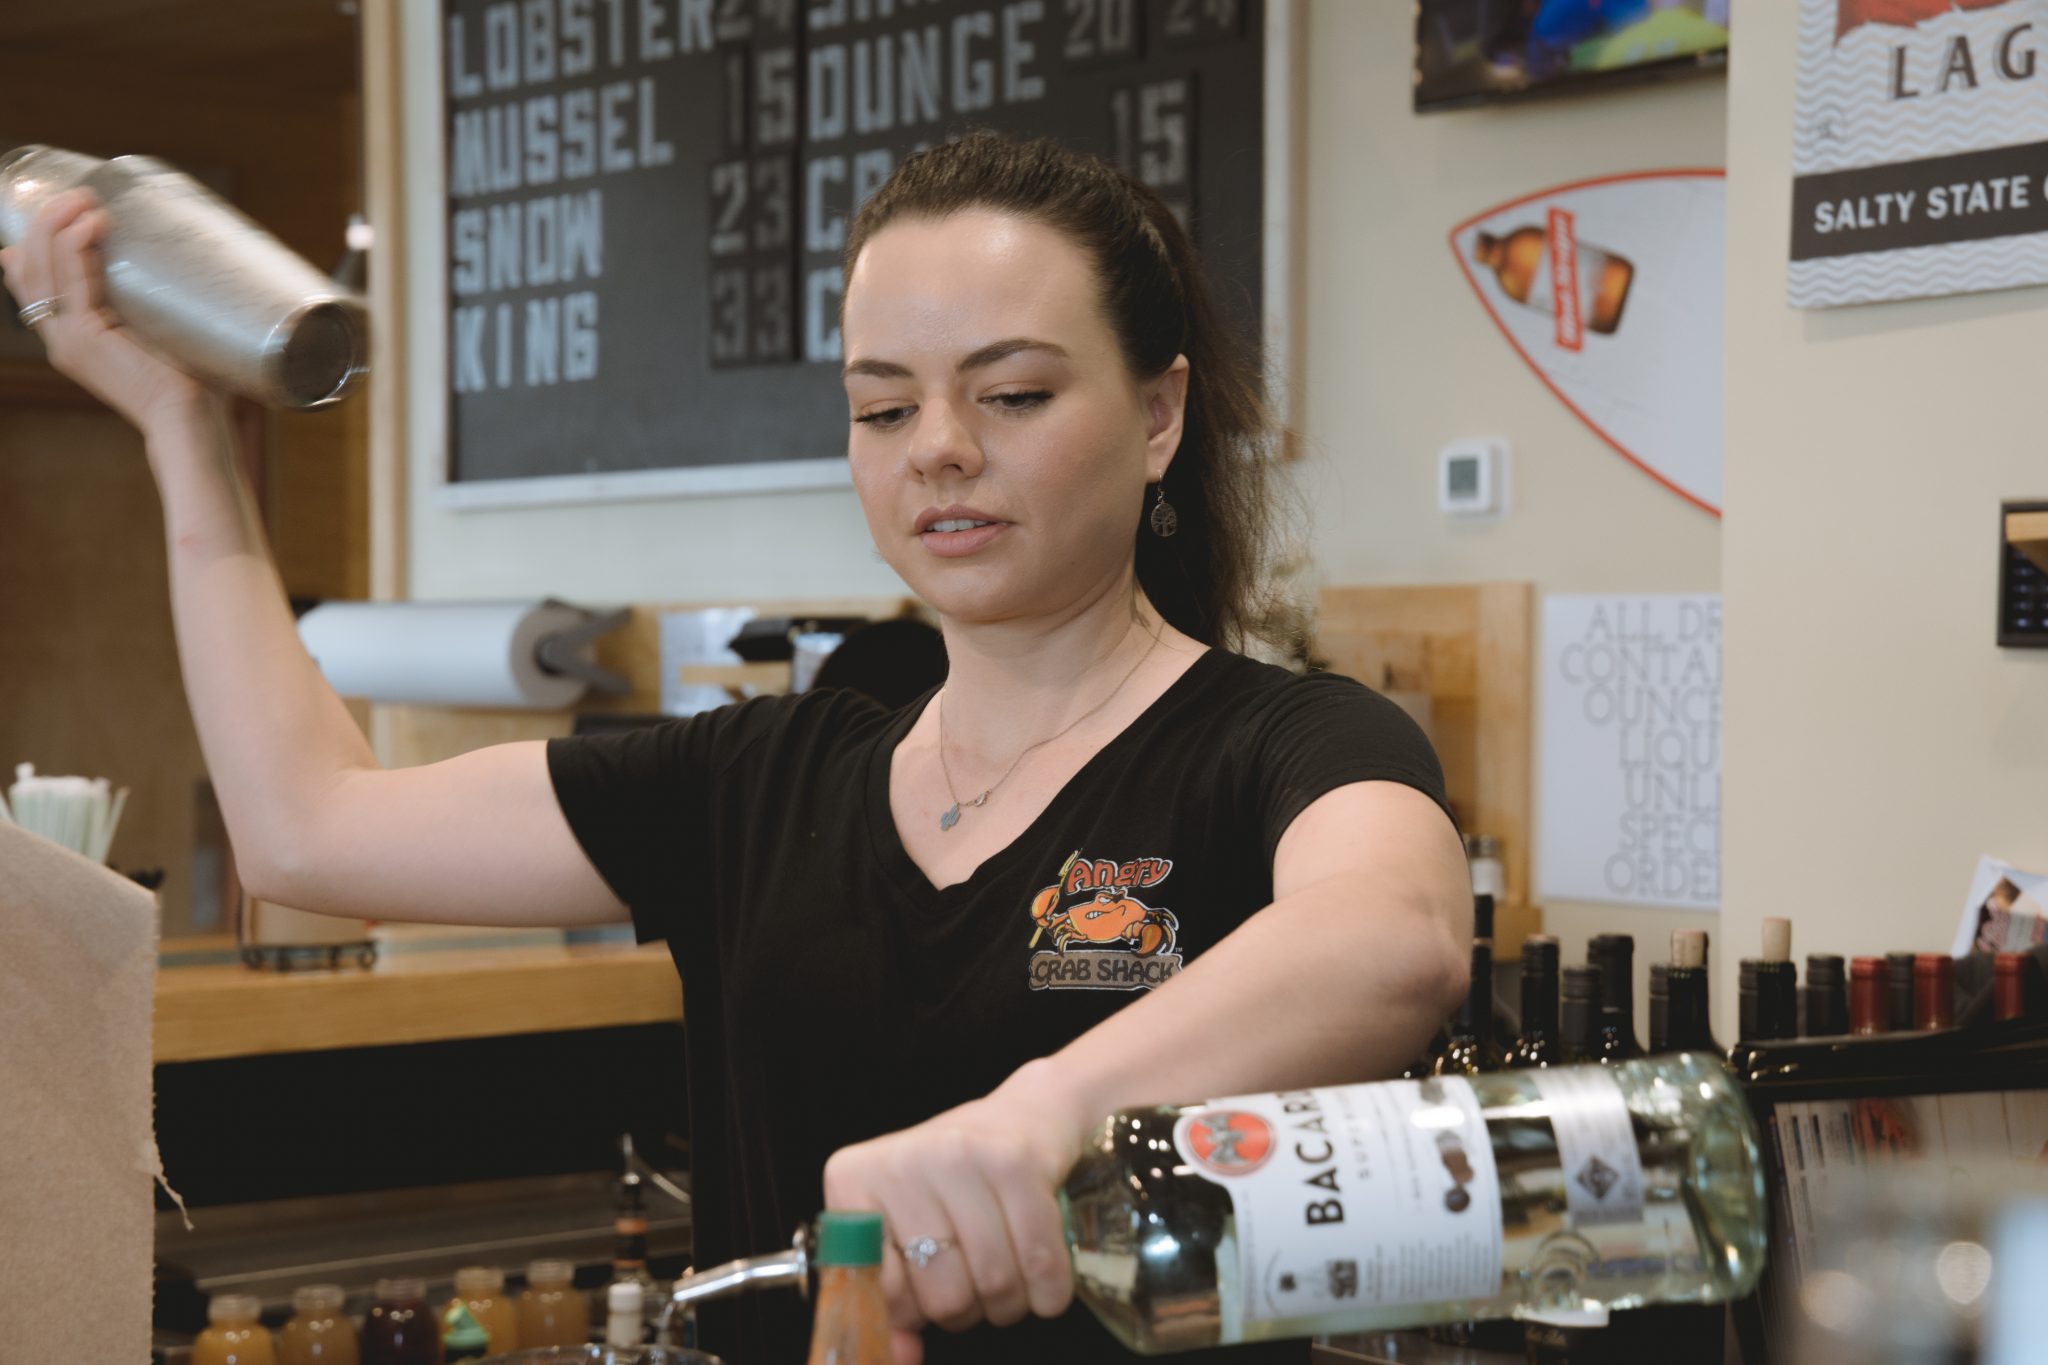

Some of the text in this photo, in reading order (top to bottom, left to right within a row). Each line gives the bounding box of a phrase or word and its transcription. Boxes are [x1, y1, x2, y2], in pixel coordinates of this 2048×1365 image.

[449, 0, 714, 97] LOBSTER
[1888, 23, 2036, 100] LAG
[452, 48, 795, 197] MUSSEL 15
[452, 156, 792, 296] SNOW 23
[1814, 191, 1916, 234] SALTY
[1927, 175, 2031, 220] STATE
[453, 291, 599, 394] KING
[1585, 601, 1663, 642] ALL
[1034, 958, 1175, 983] CRAB SHACK
